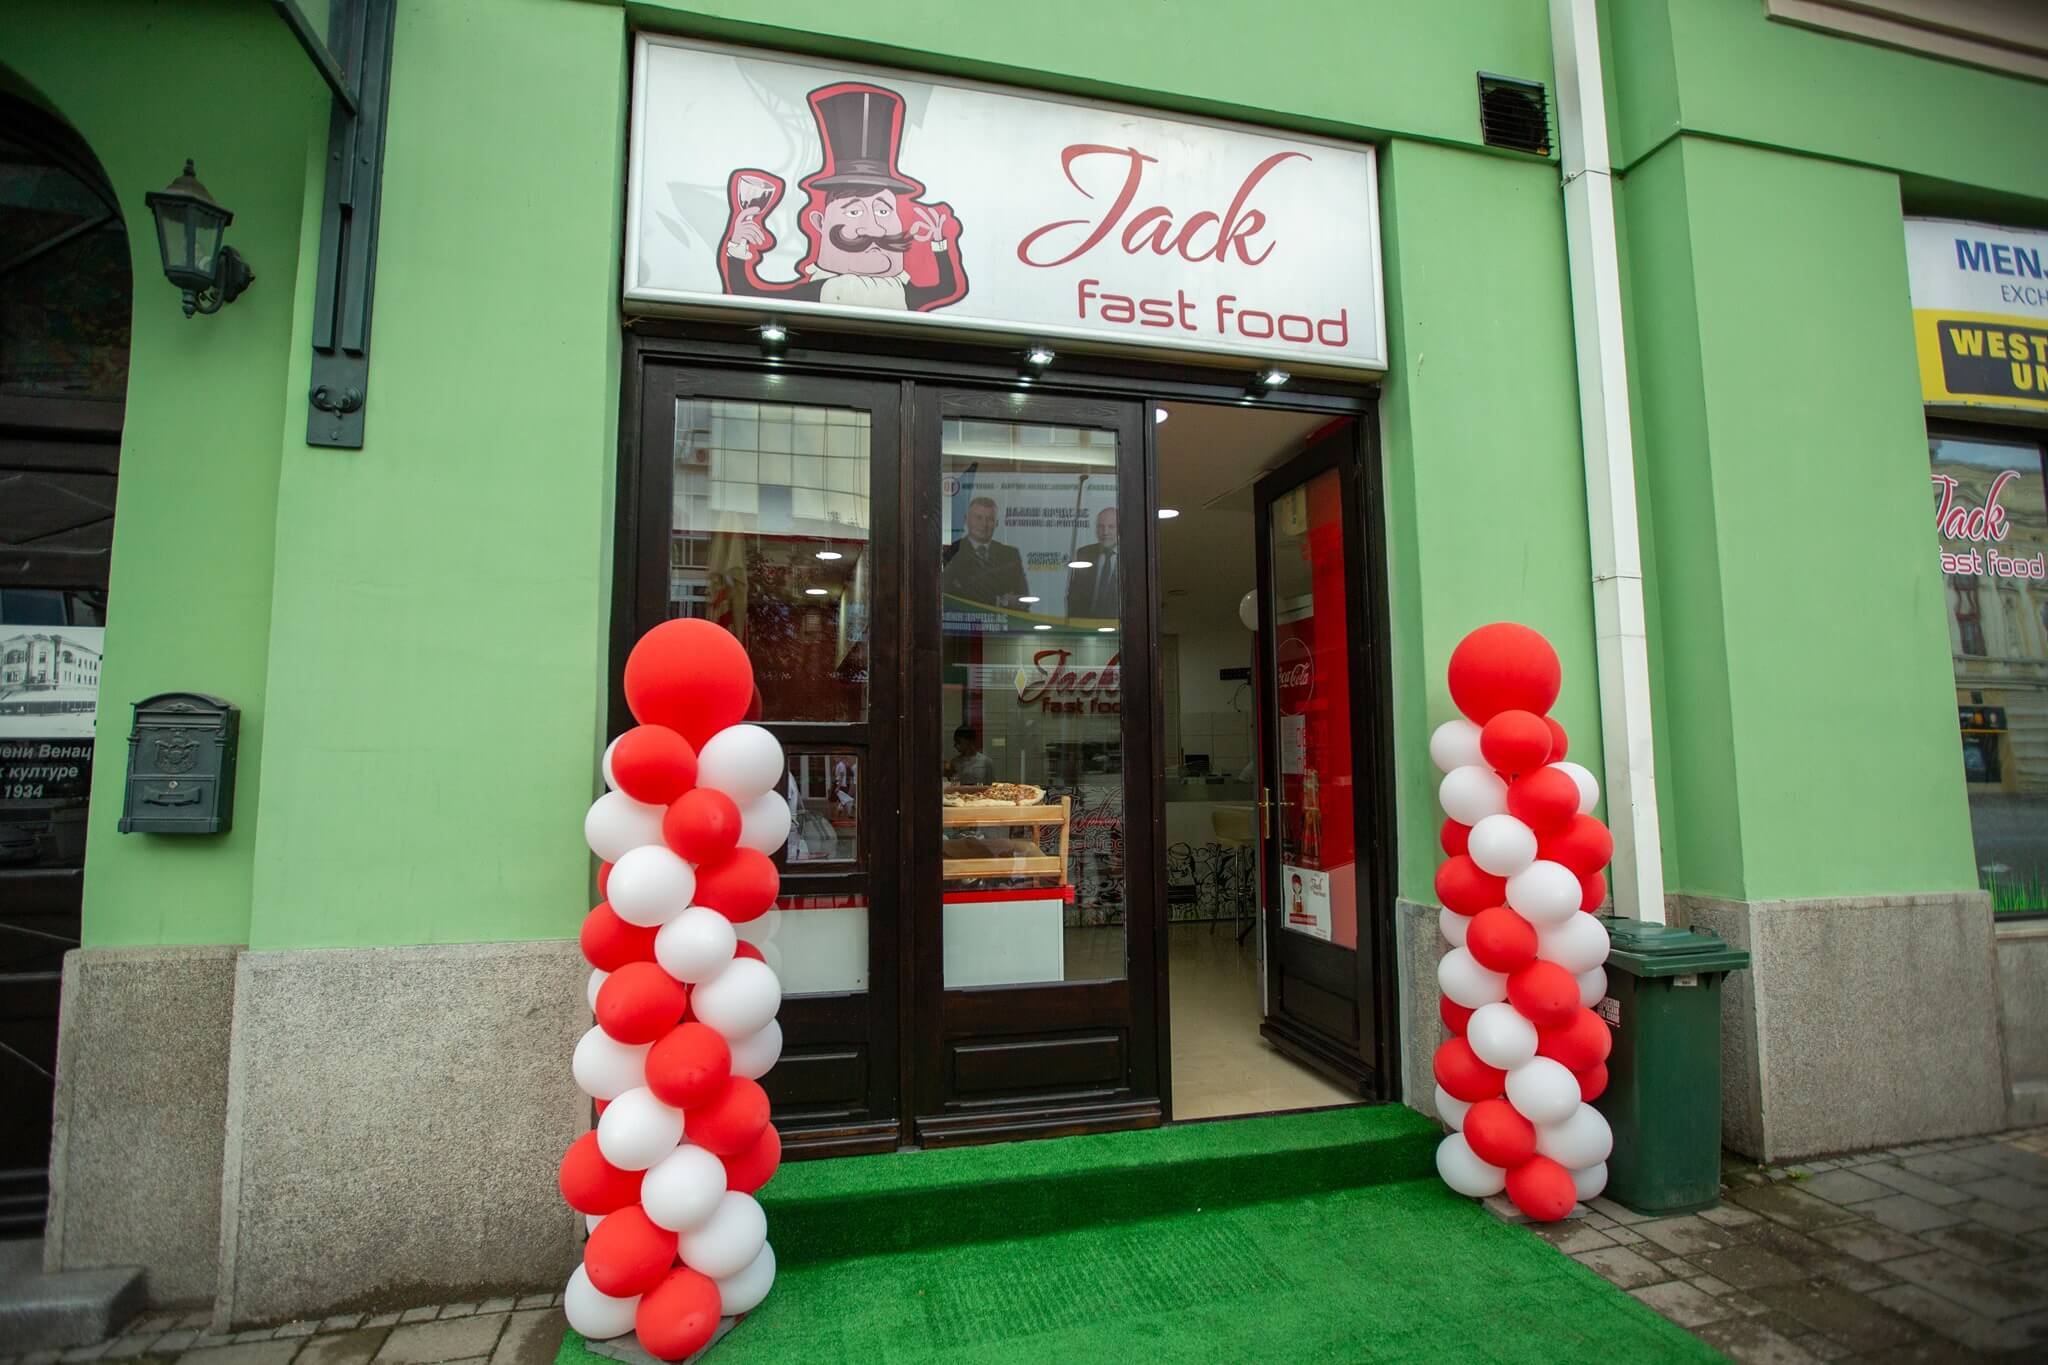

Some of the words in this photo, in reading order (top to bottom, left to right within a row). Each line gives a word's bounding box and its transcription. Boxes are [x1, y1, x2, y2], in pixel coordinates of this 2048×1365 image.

[1016, 143, 1313, 268] Jack
[1955, 238, 2048, 279] MEN
[1078, 279, 1198, 331] fast
[1216, 294, 1349, 348] food
[1949, 327, 2048, 363] WEST
[1939, 545, 1984, 576] ast
[1986, 549, 2045, 579] food
[1042, 697, 1084, 714] fast
[0, 746, 34, 759] ени
[38, 744, 92, 761] Венац
[4, 784, 44, 798] 1934
[9, 766, 79, 782] културе
